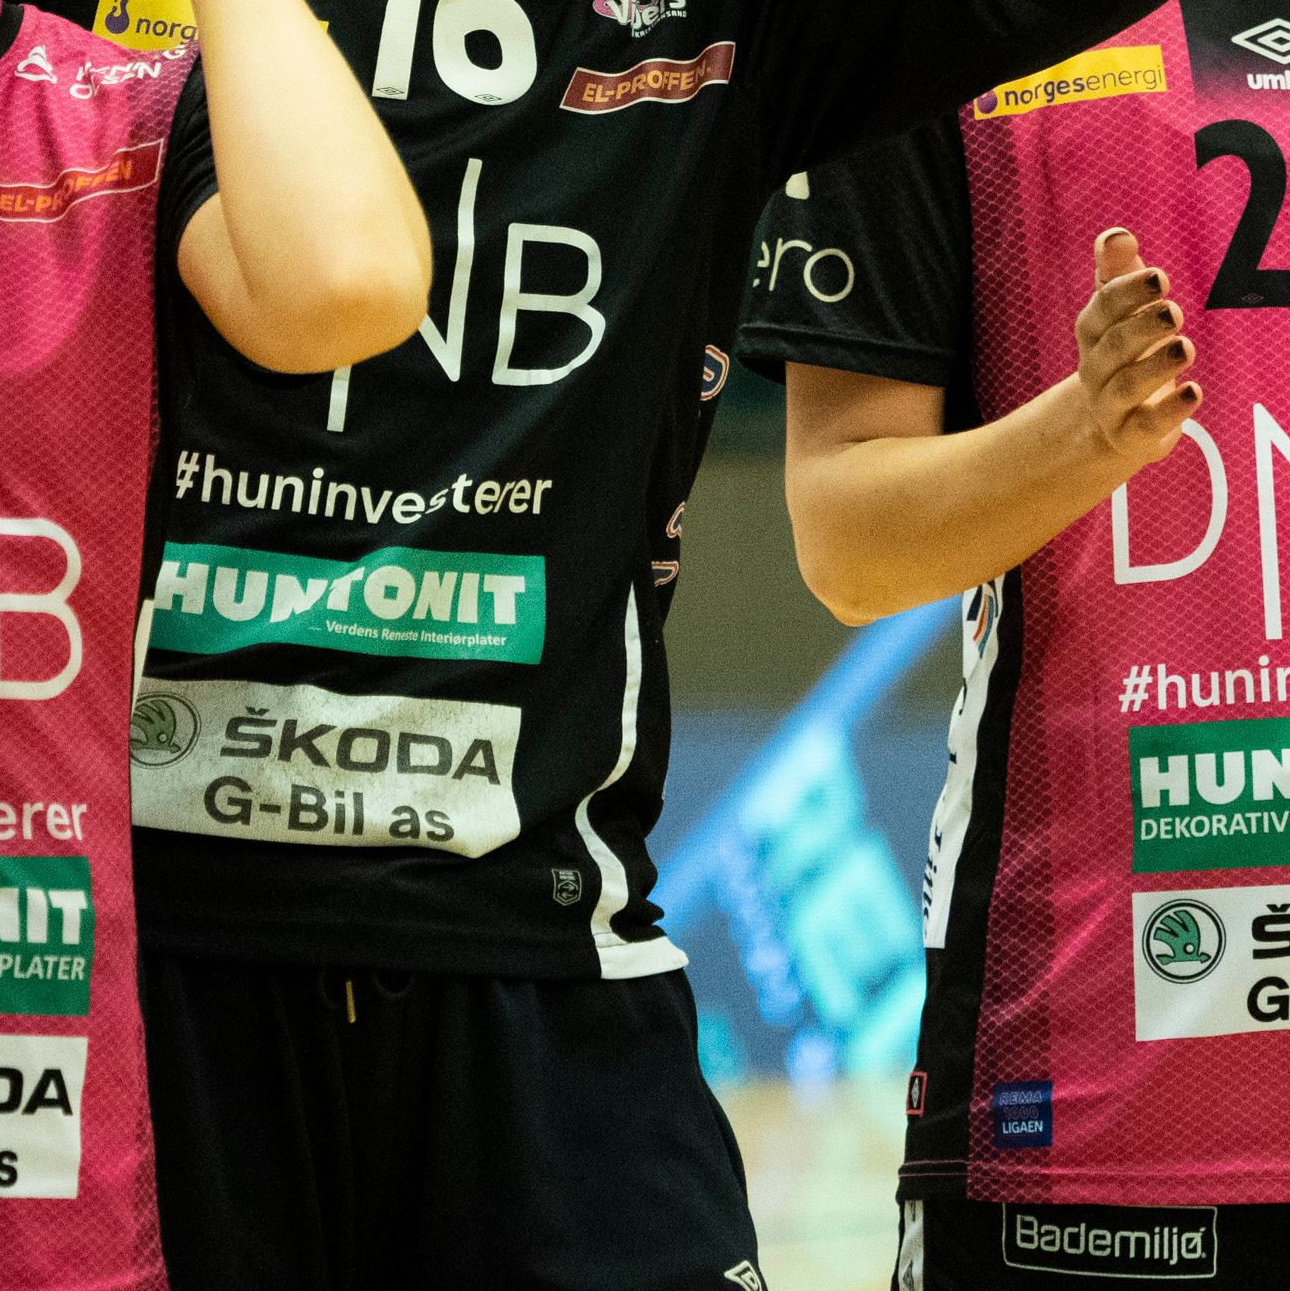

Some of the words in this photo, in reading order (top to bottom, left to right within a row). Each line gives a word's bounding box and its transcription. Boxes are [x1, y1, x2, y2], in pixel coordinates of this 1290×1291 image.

[1003, 64, 1165, 108] norgesenergi
[174, 449, 553, 525] #huninvesterer
[154, 560, 527, 627] HUNTONIT
[325, 619, 379, 640] Verdens
[420, 629, 507, 649] Interiørplater
[219, 706, 503, 787] ŠKODA
[202, 774, 365, 837] G-Bil
[387, 803, 456, 843] as
[1002, 1120, 1044, 1134] LIGAEN
